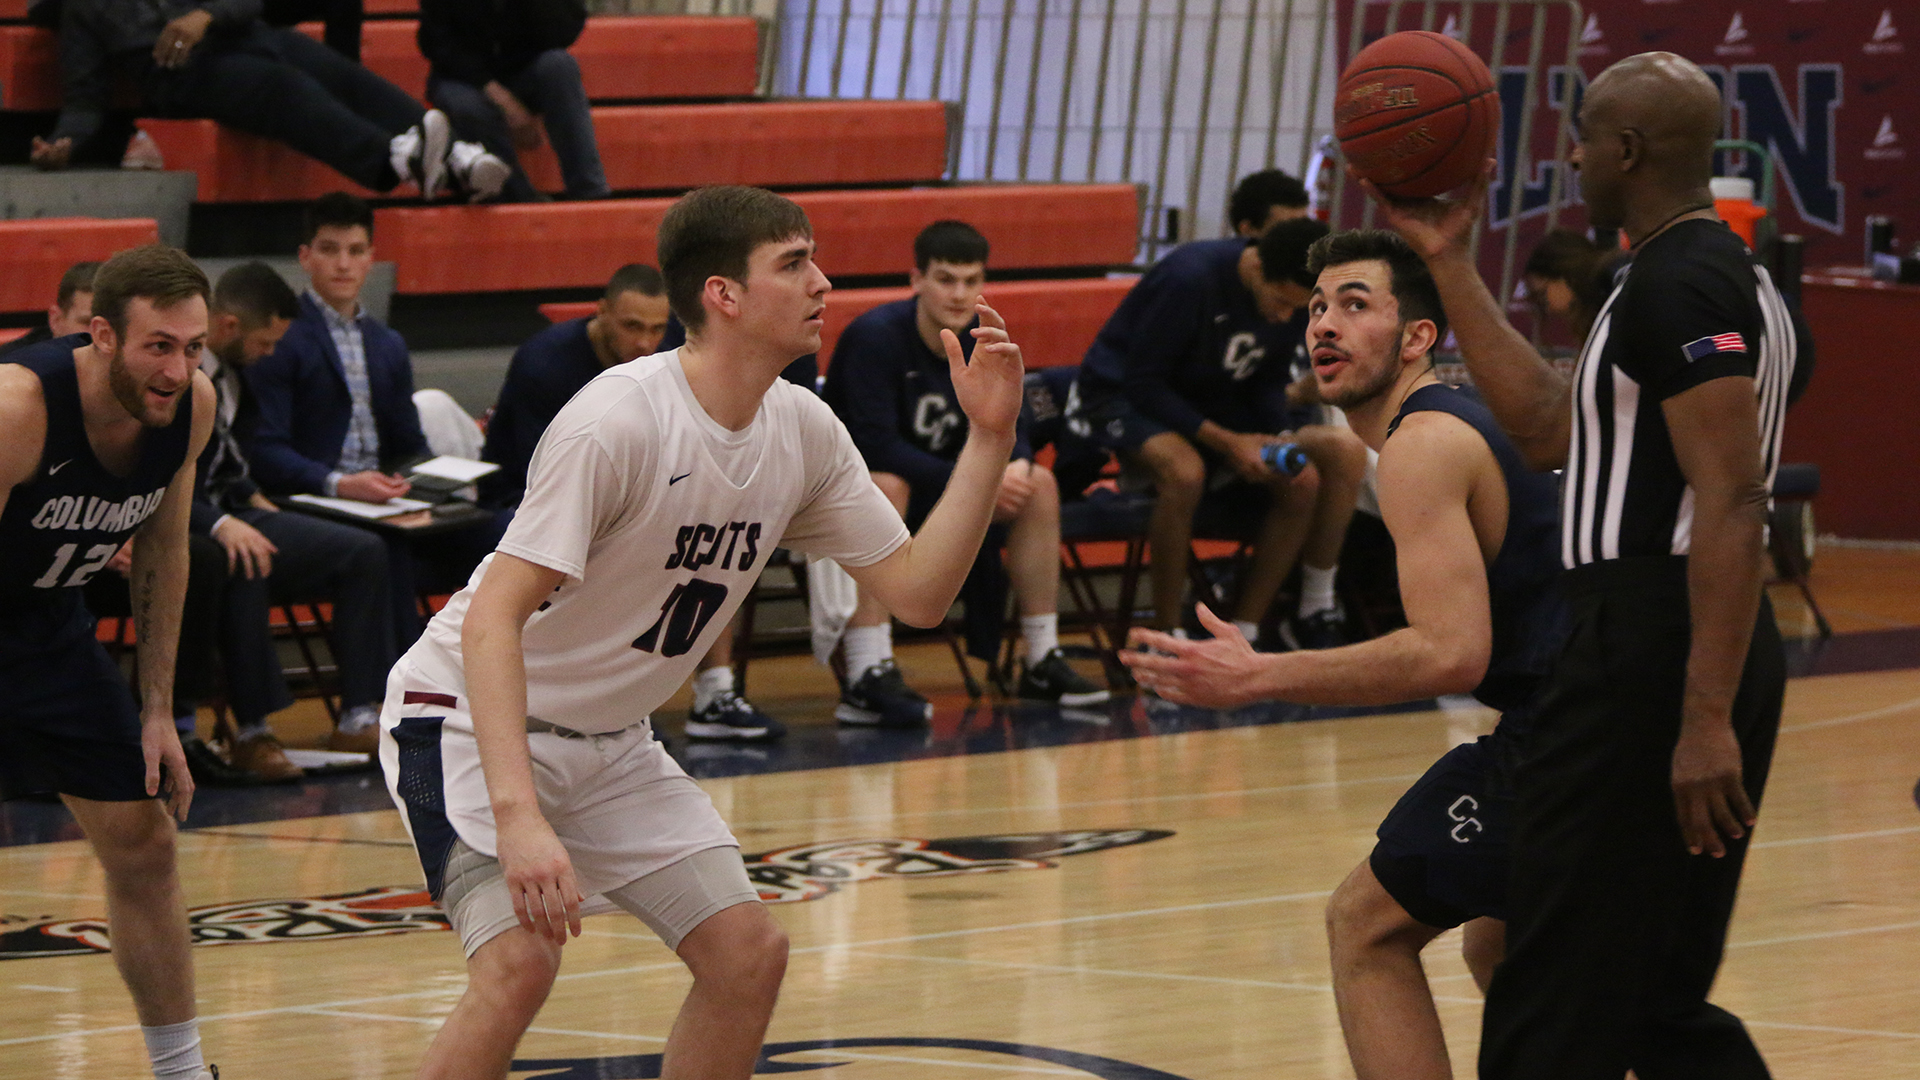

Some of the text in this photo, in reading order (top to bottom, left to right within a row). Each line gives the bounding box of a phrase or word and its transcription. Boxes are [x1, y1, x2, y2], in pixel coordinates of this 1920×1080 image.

[1488, 64, 1844, 235] LN
[33, 543, 119, 588] 12
[631, 577, 728, 658] 10
